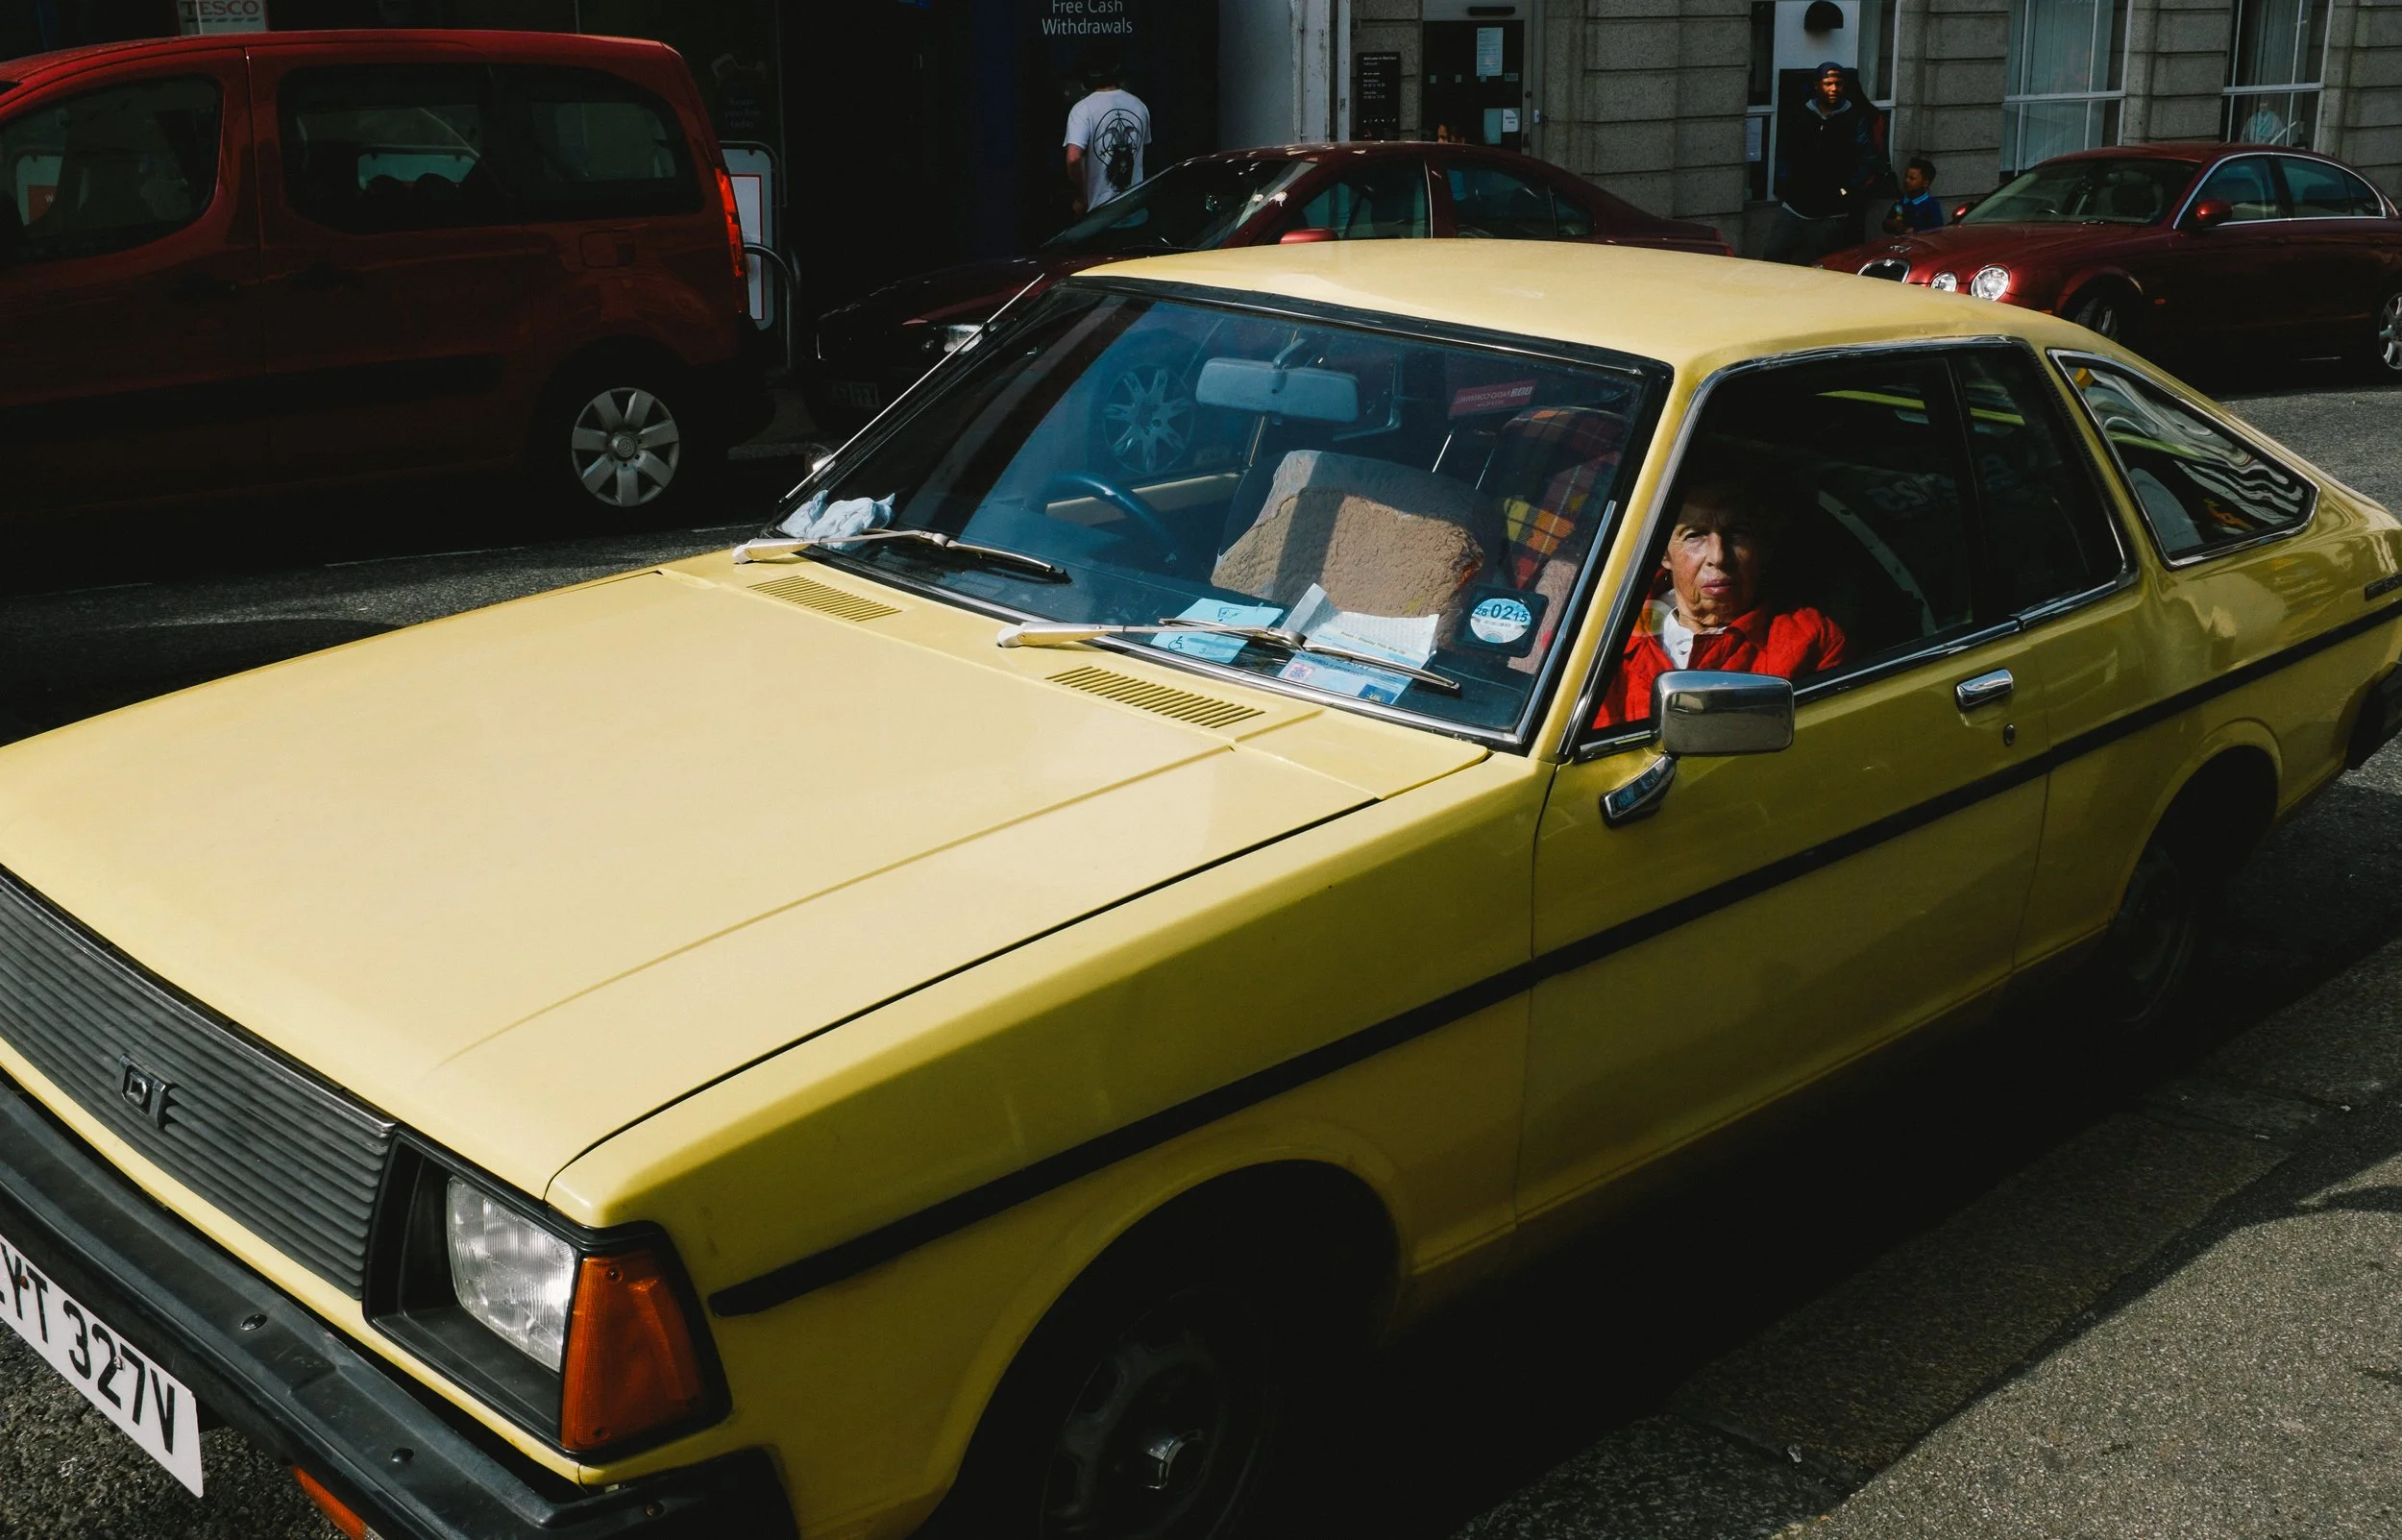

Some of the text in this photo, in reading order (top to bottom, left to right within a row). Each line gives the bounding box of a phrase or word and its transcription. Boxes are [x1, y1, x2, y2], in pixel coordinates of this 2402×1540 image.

[180, 0, 259, 15] TESCO
[1052, 0, 1123, 13] Free Cash
[1042, 16, 1133, 36] Withdrawals
[1474, 603, 1529, 623] 28 02 15
[0, 1241, 176, 1455] YT 327V
